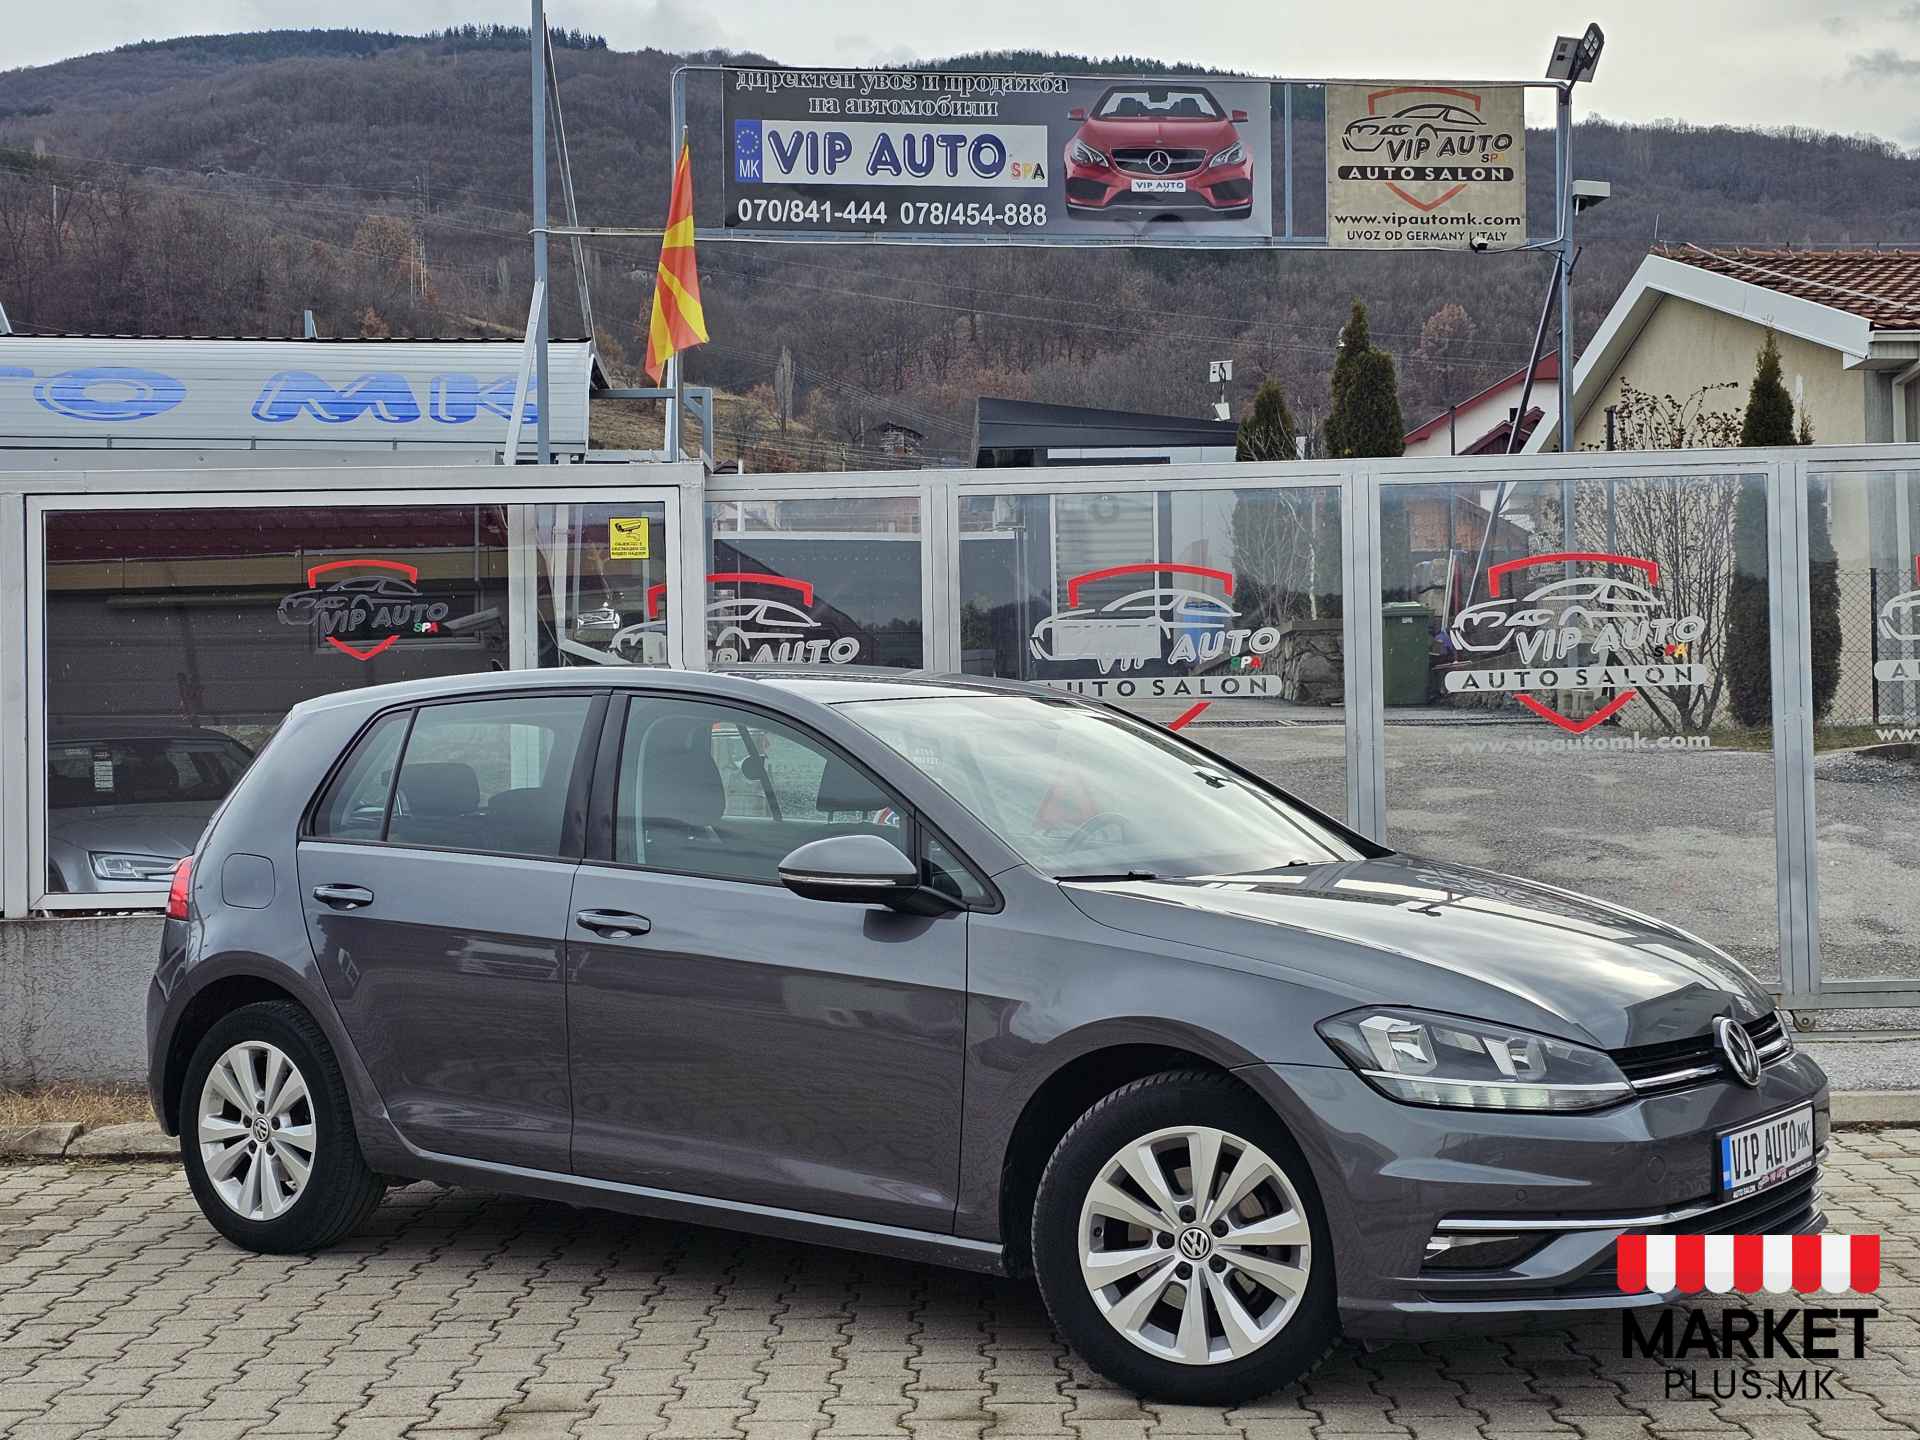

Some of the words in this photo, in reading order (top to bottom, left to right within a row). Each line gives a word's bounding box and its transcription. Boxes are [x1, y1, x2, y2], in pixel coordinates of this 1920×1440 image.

[736, 70, 855, 93] директен
[860, 73, 917, 94] увоз
[925, 75, 940, 91] и
[945, 72, 1069, 97] продажба
[808, 97, 839, 114] на
[845, 96, 999, 117] автомобили
[767, 130, 852, 175] VIP
[866, 133, 1007, 178] AUTO
[1386, 137, 1431, 163] VIP
[1435, 133, 1513, 160] AUTO
[738, 159, 760, 179] MK
[1010, 161, 1046, 180] SPA
[1349, 167, 1415, 180] AUTO
[1424, 168, 1505, 181] SALON
[1136, 181, 1153, 189] VIP
[1155, 181, 1184, 190] AUTO
[737, 198, 888, 225] 070/841-444
[900, 201, 1047, 227] 078/454-888
[1335, 212, 1521, 228] www.vipautomk.com
[1347, 231, 1381, 240] UVOZ
[1384, 231, 1403, 240] OD
[1406, 231, 1465, 241] GERMANY
[251, 371, 539, 425] MK
[319, 608, 367, 634] VIP
[371, 602, 449, 628] AUTO
[413, 622, 440, 633] SPA
[1167, 626, 1281, 665] AUTO
[1516, 627, 1582, 665] VIP
[1590, 615, 1705, 656] AUTO
[1652, 643, 1689, 659] SPA
[1151, 676, 1268, 697] SALON
[1462, 669, 1559, 690] AUTO
[1575, 665, 1694, 688] SALON
[1731, 1132, 1760, 1180] VIP
[1764, 1120, 1797, 1170] AUTO
